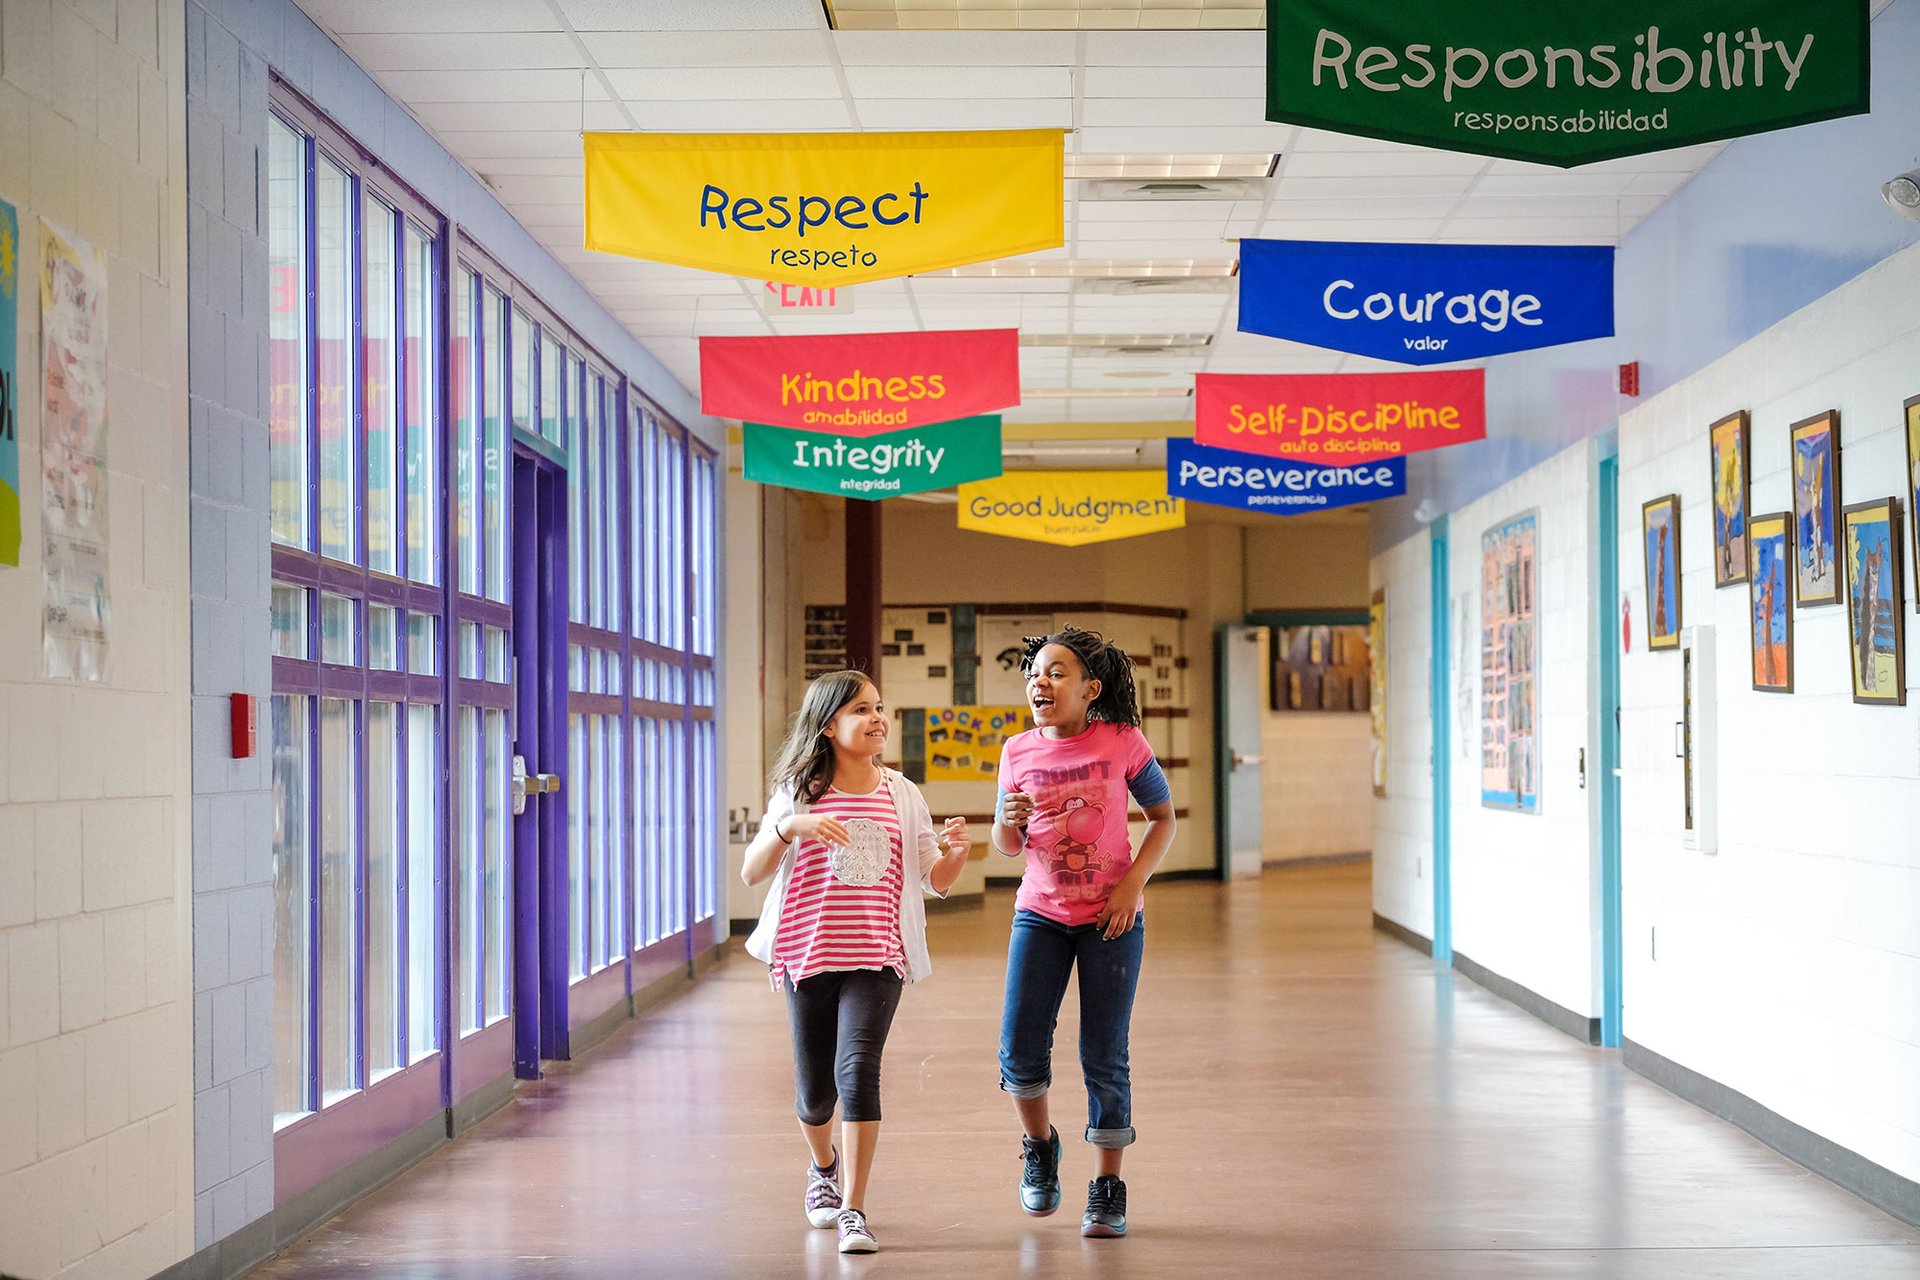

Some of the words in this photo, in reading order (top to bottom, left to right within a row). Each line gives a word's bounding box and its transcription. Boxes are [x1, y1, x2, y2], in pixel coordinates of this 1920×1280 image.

[1311, 26, 1814, 102] Responsibility
[1453, 107, 1668, 134] responsabilidad
[700, 182, 929, 237] Respect
[770, 244, 877, 271] respeto
[1323, 279, 1544, 332] Courage
[1403, 336, 1449, 351] valor
[781, 369, 946, 406] Kindness
[803, 407, 907, 426] amabilidad
[1227, 401, 1461, 437] Self-Discipline
[793, 438, 945, 475] Integrity
[1280, 438, 1319, 454] auto
[1323, 437, 1401, 455] disciplina
[840, 477, 900, 492] integridad
[1179, 460, 1394, 491] Perseverance
[970, 495, 1042, 518] Good
[1047, 495, 1178, 524] Judgment
[929, 709, 983, 731] ROCK
[990, 711, 1017, 730] ON
[1033, 760, 1112, 787] DON'T
